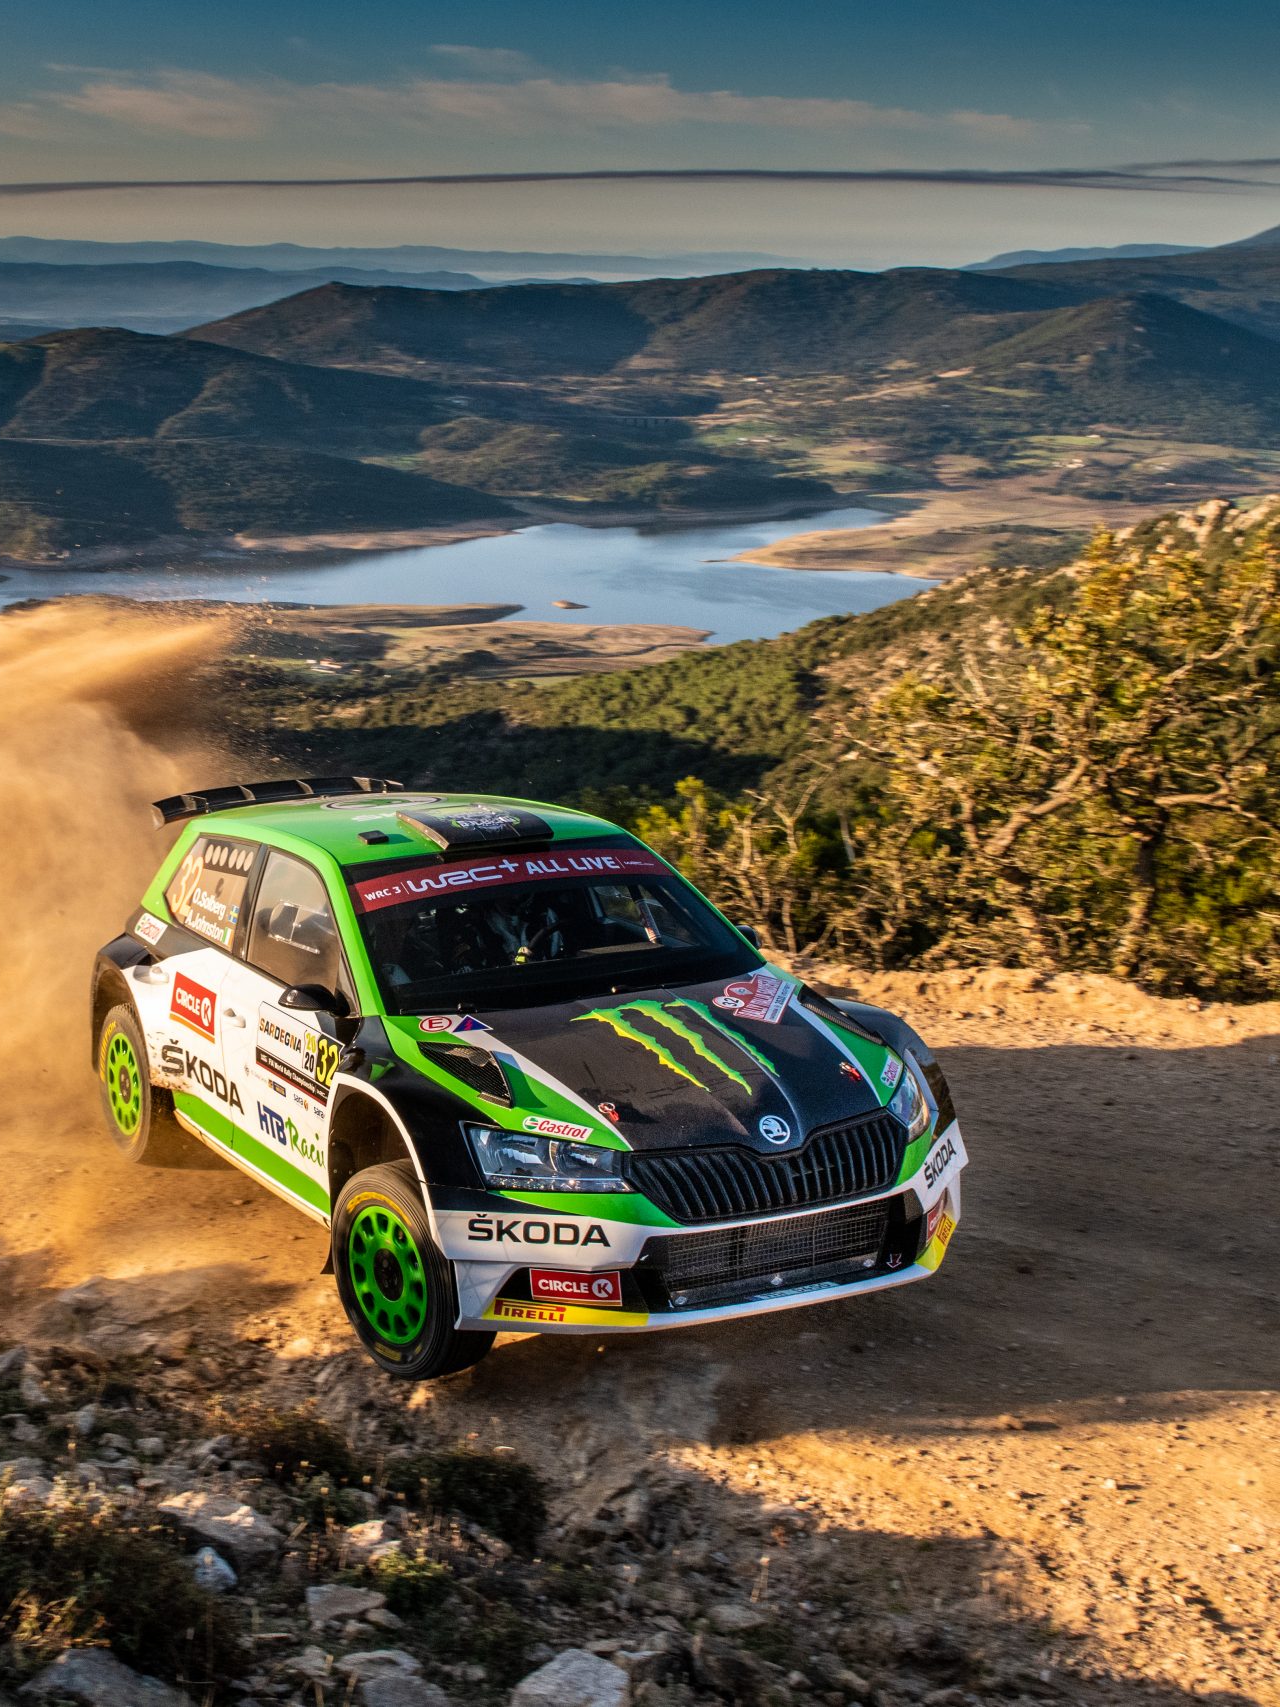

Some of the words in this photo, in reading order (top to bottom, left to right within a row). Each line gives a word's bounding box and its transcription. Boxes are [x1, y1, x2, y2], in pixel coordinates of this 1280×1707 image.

[171, 854, 205, 917] 32
[363, 889, 390, 902] WRC
[393, 886, 402, 895] 3
[525, 859, 569, 875] ALL
[568, 856, 620, 871] LIVE
[192, 887, 227, 921] O.Solberg
[175, 987, 201, 1016] CIRCLE
[202, 998, 212, 1027] K
[722, 997, 740, 1007] 32
[259, 1018, 302, 1054] SARDEGNA
[428, 1017, 443, 1029] E
[306, 1032, 317, 1053] 20
[161, 1038, 245, 1116] ŠKODA
[304, 1053, 315, 1073] 20
[316, 1038, 339, 1087] 32
[257, 1100, 287, 1146] HTB
[538, 1119, 588, 1139] Castrol
[923, 1138, 957, 1190] ŠKODA
[467, 1213, 611, 1247] ŠKODA
[538, 1278, 589, 1294] CIRCLE
[593, 1279, 613, 1298] K
[493, 1300, 567, 1322] PIRELLI
